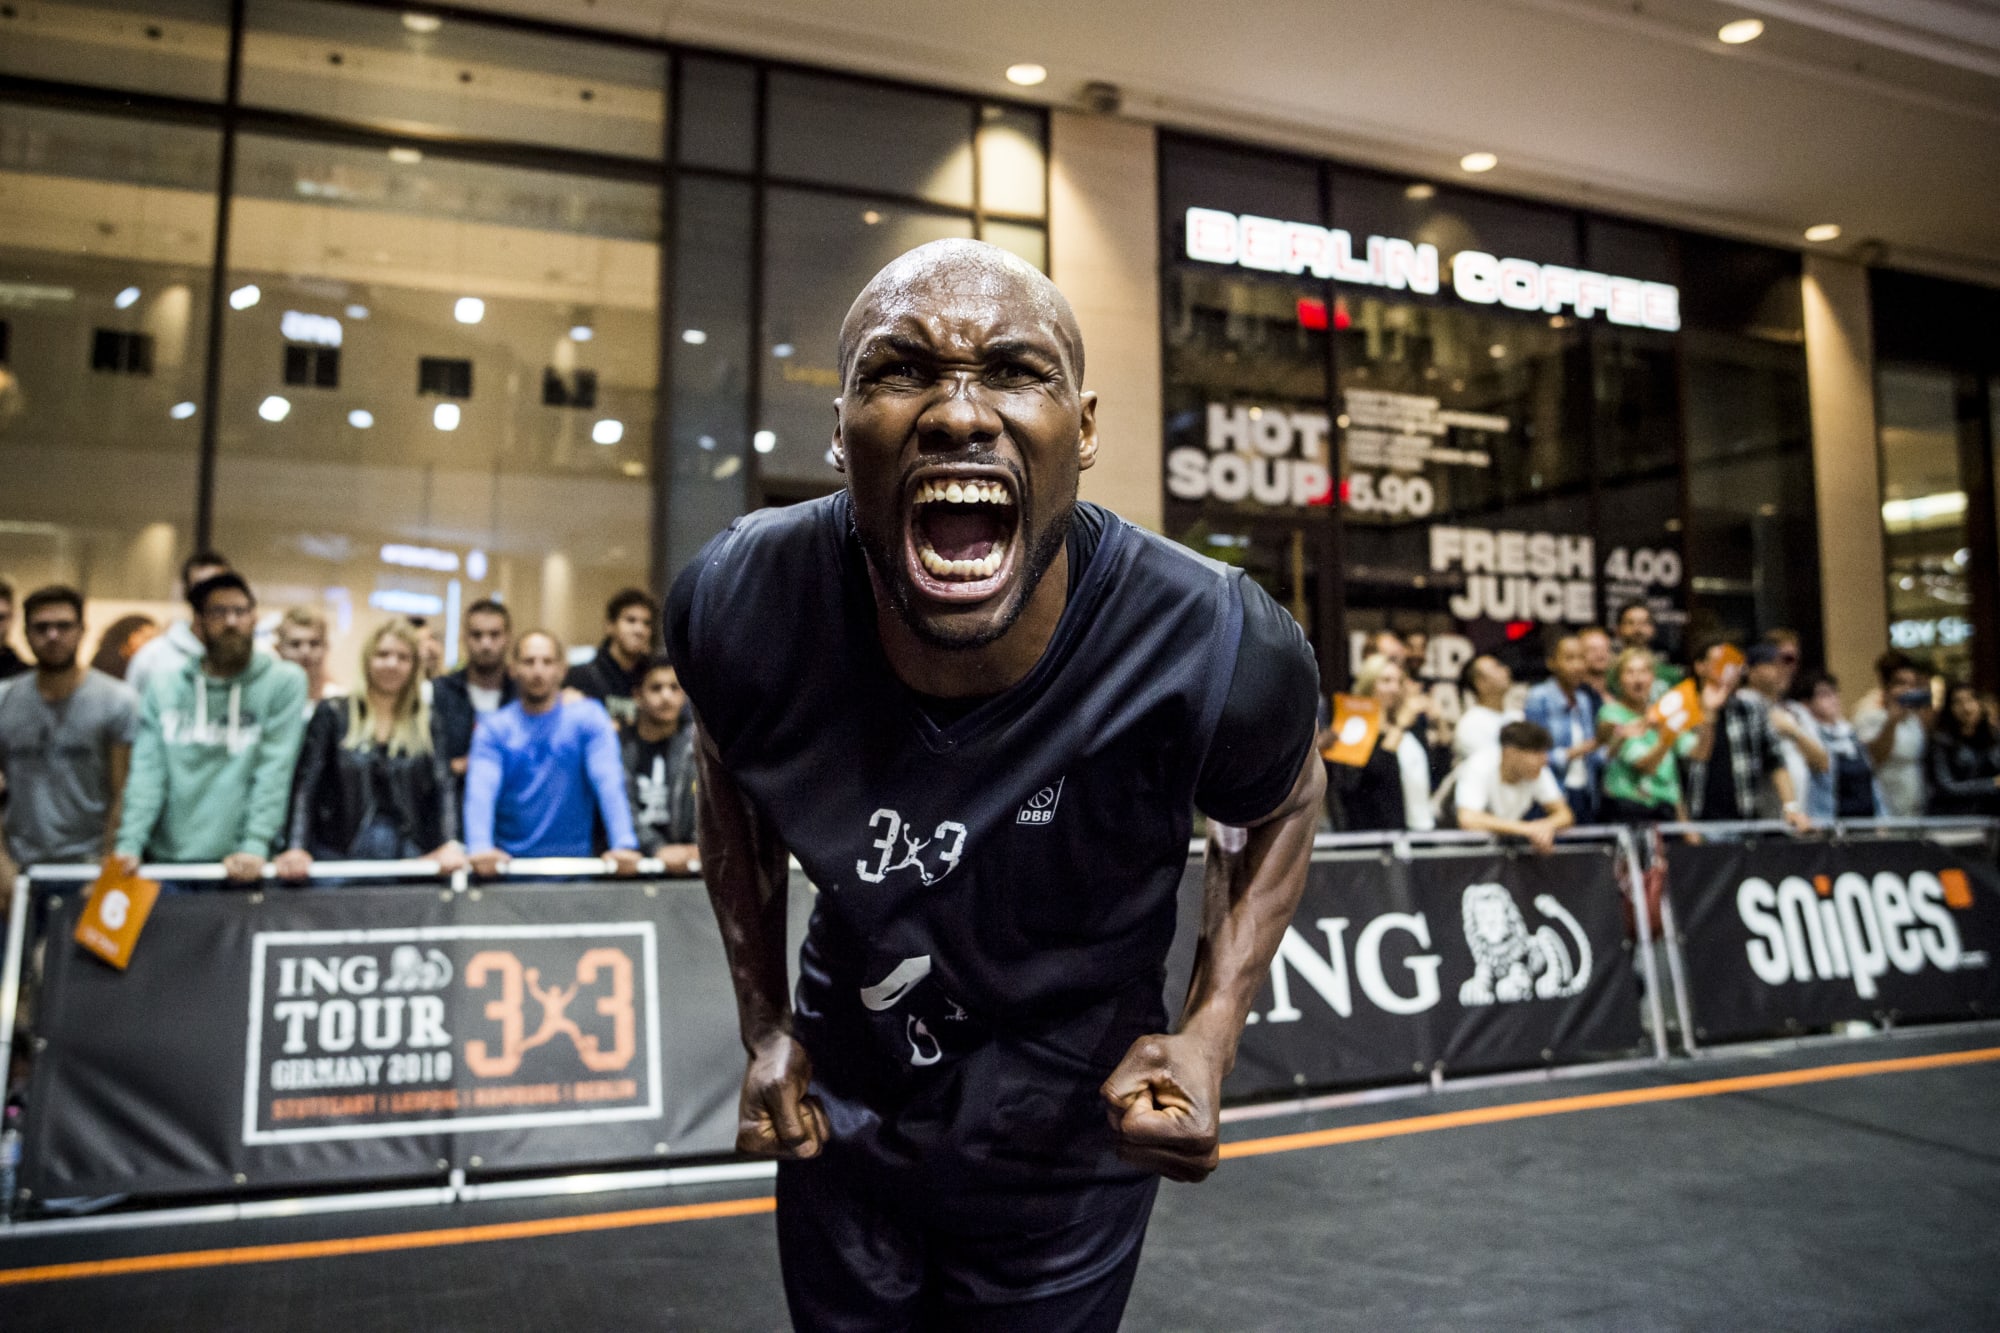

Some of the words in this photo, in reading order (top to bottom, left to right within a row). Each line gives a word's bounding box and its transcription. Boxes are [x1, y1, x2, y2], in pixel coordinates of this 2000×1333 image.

[1185, 206, 1439, 294] BERLIN
[1453, 250, 1681, 331] COFFEE
[1206, 403, 1330, 457] HOT
[1429, 525, 1596, 578] FRESH
[1604, 547, 1682, 588] 4.00
[1449, 575, 1597, 623] JUICE
[1020, 809, 1052, 823] DBB
[1737, 869, 1962, 999] snipes
[276, 955, 379, 996] ING
[1245, 911, 1442, 1025] NG
[274, 996, 452, 1054] TOUR
[270, 1054, 384, 1091] GERMANY
